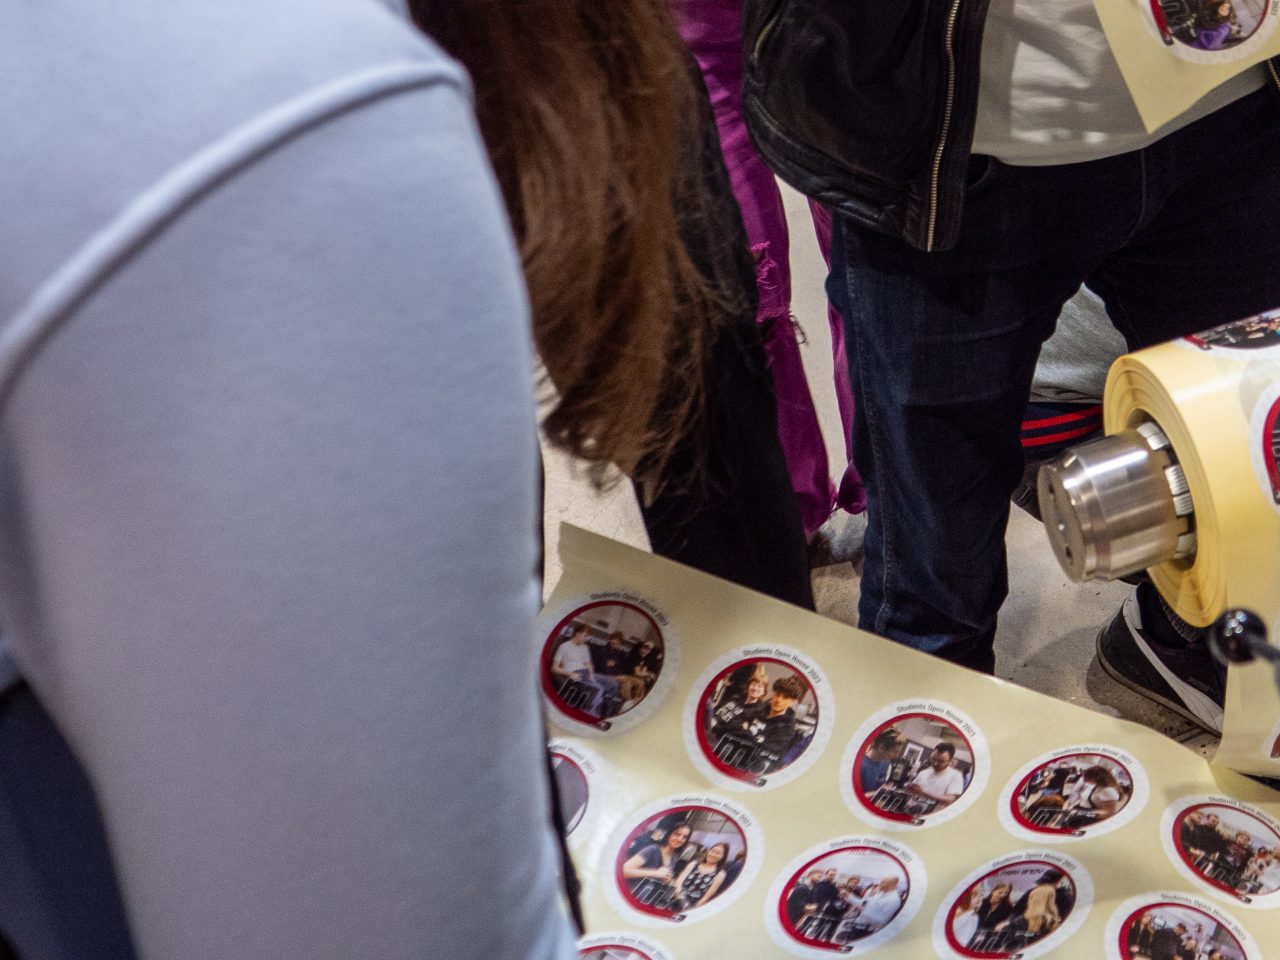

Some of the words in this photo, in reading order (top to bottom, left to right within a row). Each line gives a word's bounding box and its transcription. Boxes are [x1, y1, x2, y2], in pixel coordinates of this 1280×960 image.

[742, 648, 773, 657] Students
[774, 648, 792, 660] Open
[791, 655, 809, 670] House
[896, 703, 926, 713] Students
[927, 703, 944, 714] Open
[945, 709, 963, 724] House
[704, 797, 722, 808] Open
[722, 803, 740, 816] House
[1160, 893, 1193, 904] Students
[1193, 899, 1212, 913] Open
